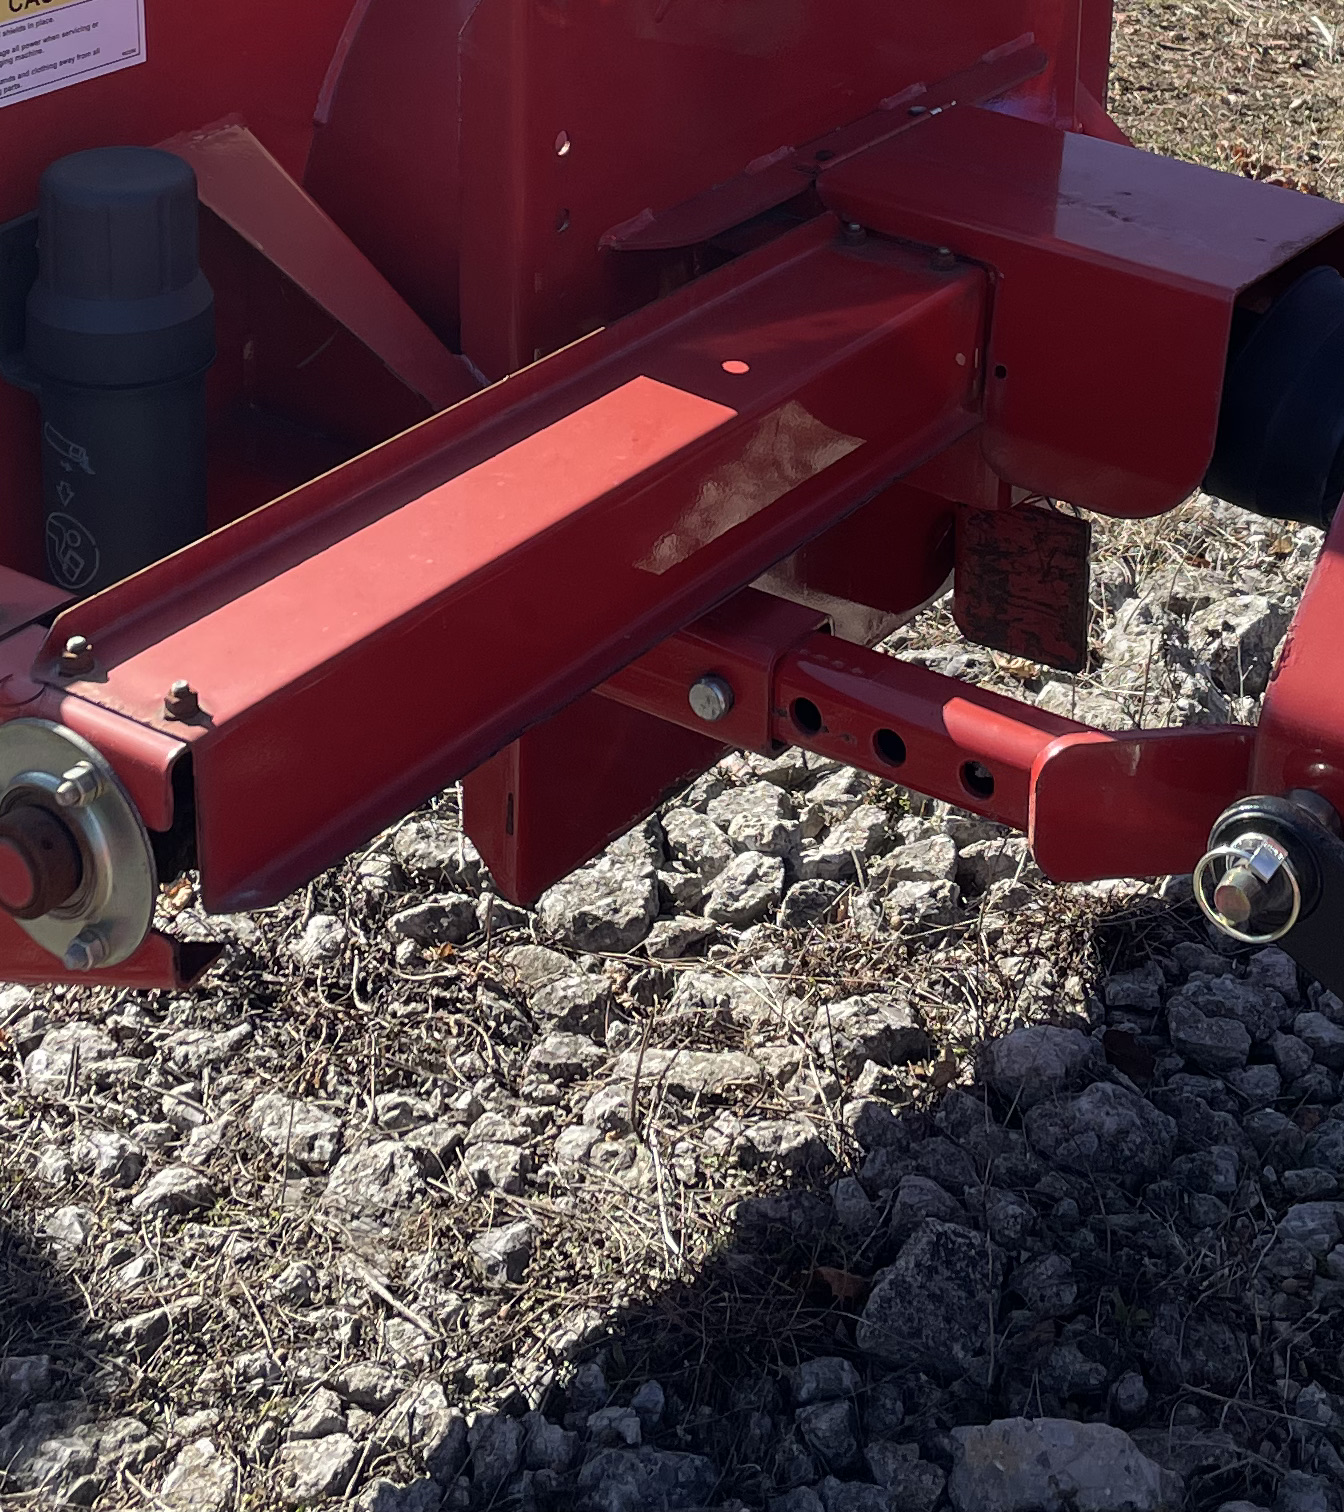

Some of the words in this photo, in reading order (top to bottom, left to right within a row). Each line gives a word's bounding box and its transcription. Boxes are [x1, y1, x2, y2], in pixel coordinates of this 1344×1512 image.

[3, 26, 26, 36] shields
[21, 40, 41, 51] power
[43, 34, 60, 43] when
[62, 24, 90, 37] servicing
[92, 21, 99, 29] or
[18, 70, 30, 79] and
[31, 62, 57, 75] clothing
[59, 57, 75, 66] away
[77, 52, 91, 60] from
